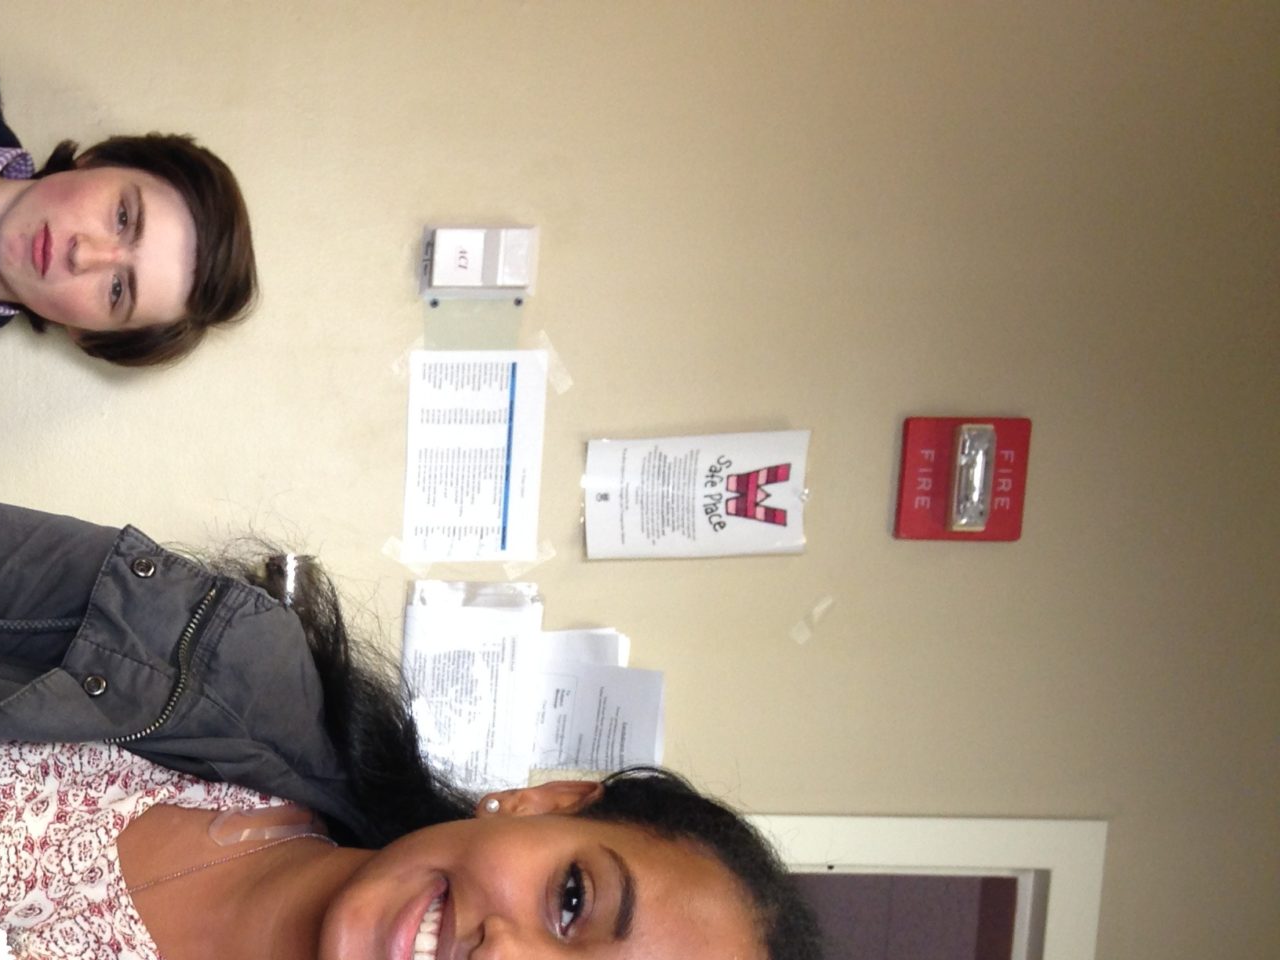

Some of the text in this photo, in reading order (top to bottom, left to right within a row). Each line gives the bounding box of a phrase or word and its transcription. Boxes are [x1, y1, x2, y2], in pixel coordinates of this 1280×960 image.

[702, 455, 732, 532] Safe Place
[726, 463, 792, 527] W
[914, 448, 934, 510] FIRE
[994, 450, 1014, 510] FIRE
